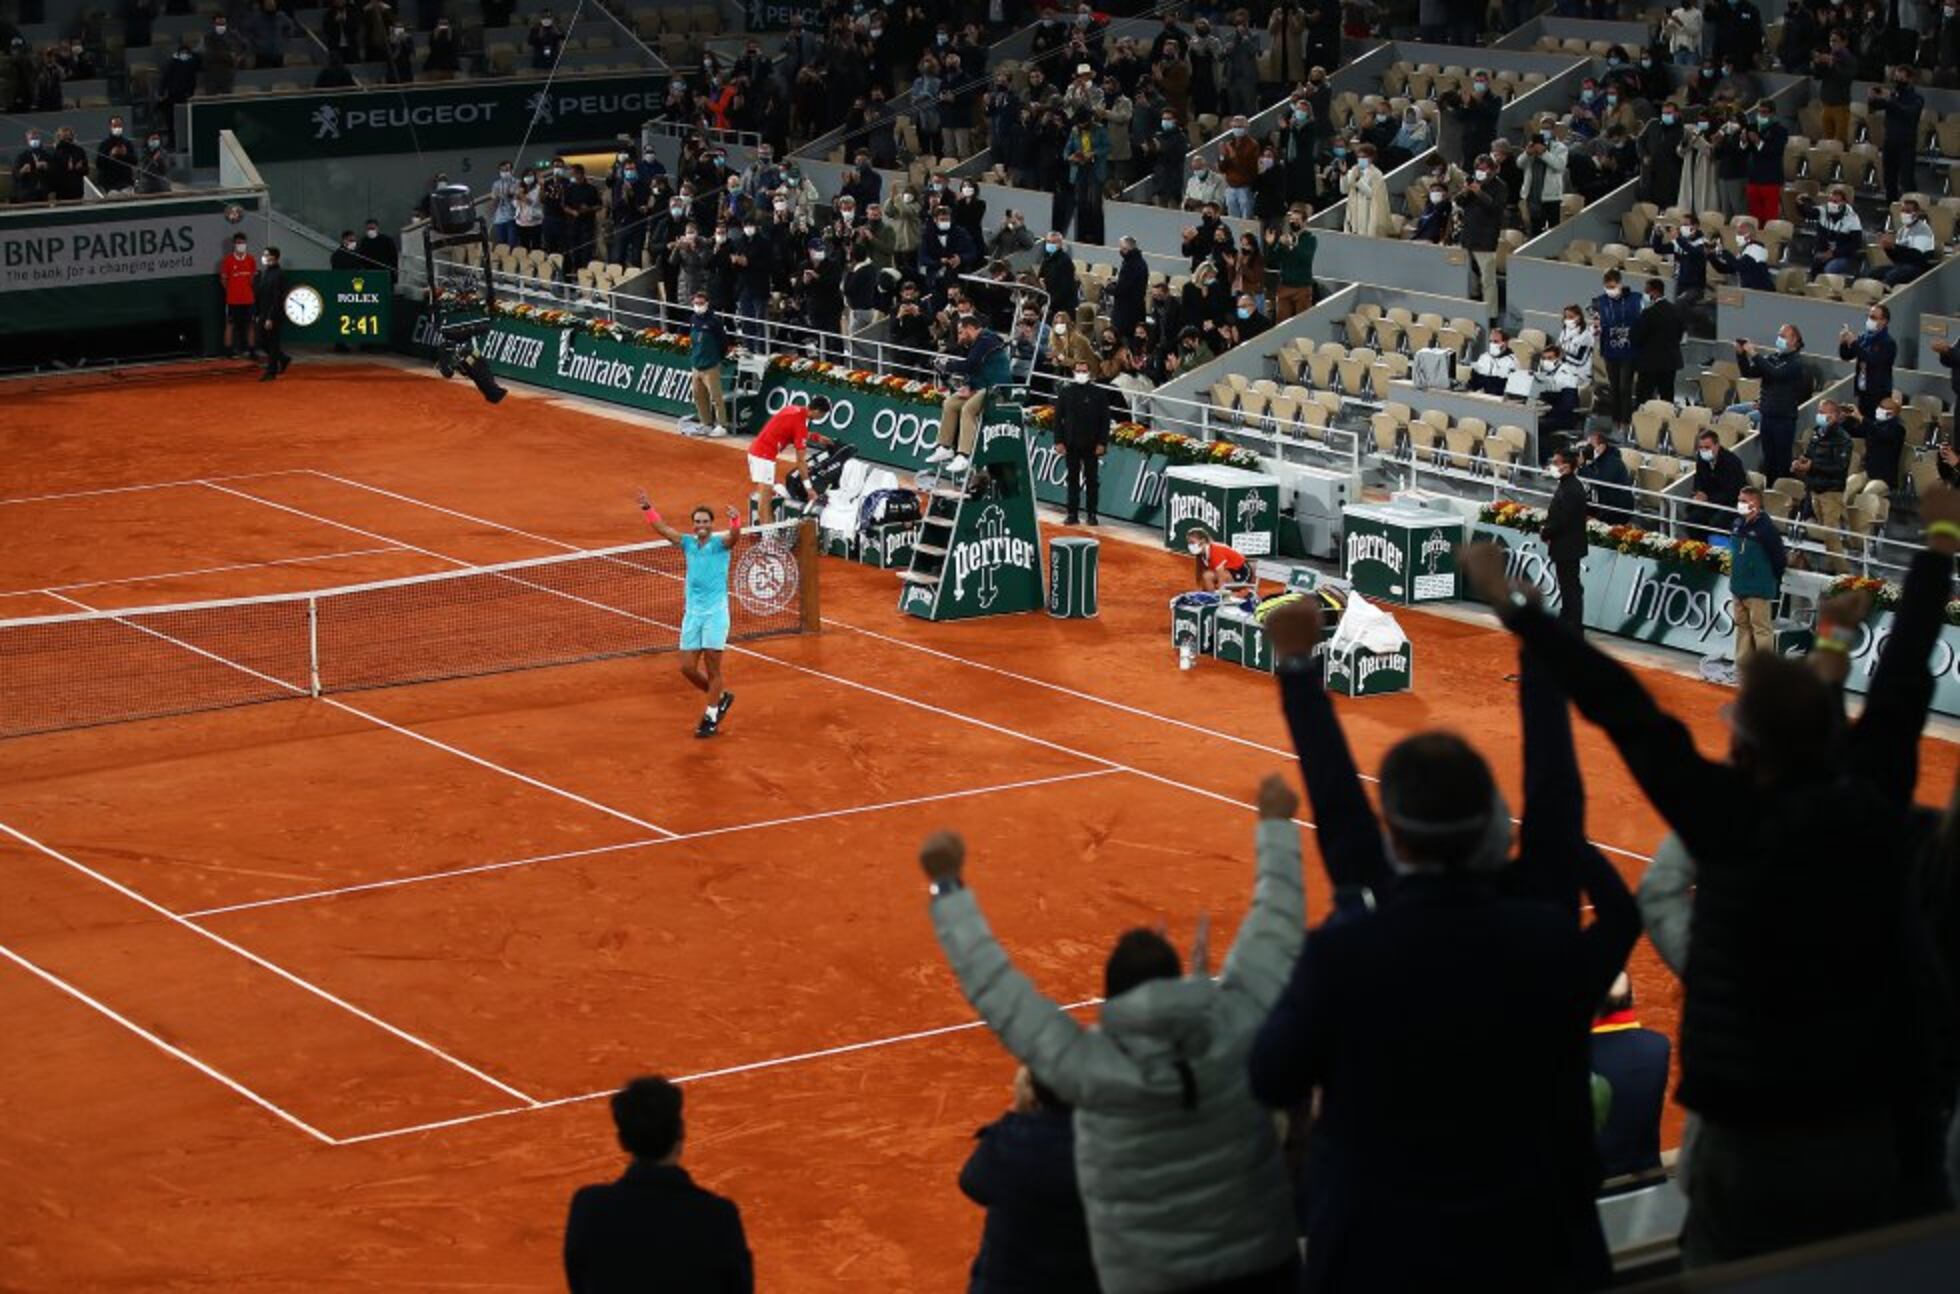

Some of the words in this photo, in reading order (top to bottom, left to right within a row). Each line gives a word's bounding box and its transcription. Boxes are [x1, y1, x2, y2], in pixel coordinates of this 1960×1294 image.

[346, 102, 498, 129] PEUGEOT
[558, 92, 662, 116] PEUGE
[4, 237, 65, 268] BNP
[73, 225, 195, 261] PARIBAS
[6, 271, 29, 282] The
[33, 265, 63, 281] bank
[66, 264, 85, 281] for
[88, 266, 96, 276] a
[100, 259, 155, 275] changing
[158, 255, 194, 269] world
[337, 293, 380, 303] ROLEX
[339, 314, 379, 335] 2:41
[481, 329, 505, 359] FLY
[500, 334, 544, 369] BETTER
[557, 340, 635, 389] Emirates
[636, 362, 664, 395] FLY
[657, 367, 695, 403] BETTE
[872, 408, 942, 457] opp
[1169, 490, 1221, 542] perrier
[883, 525, 921, 565] perri
[953, 527, 1035, 601] perrier
[1345, 529, 1403, 581] perrier
[1624, 564, 1734, 642] Infosys
[1358, 653, 1407, 693] perrier
